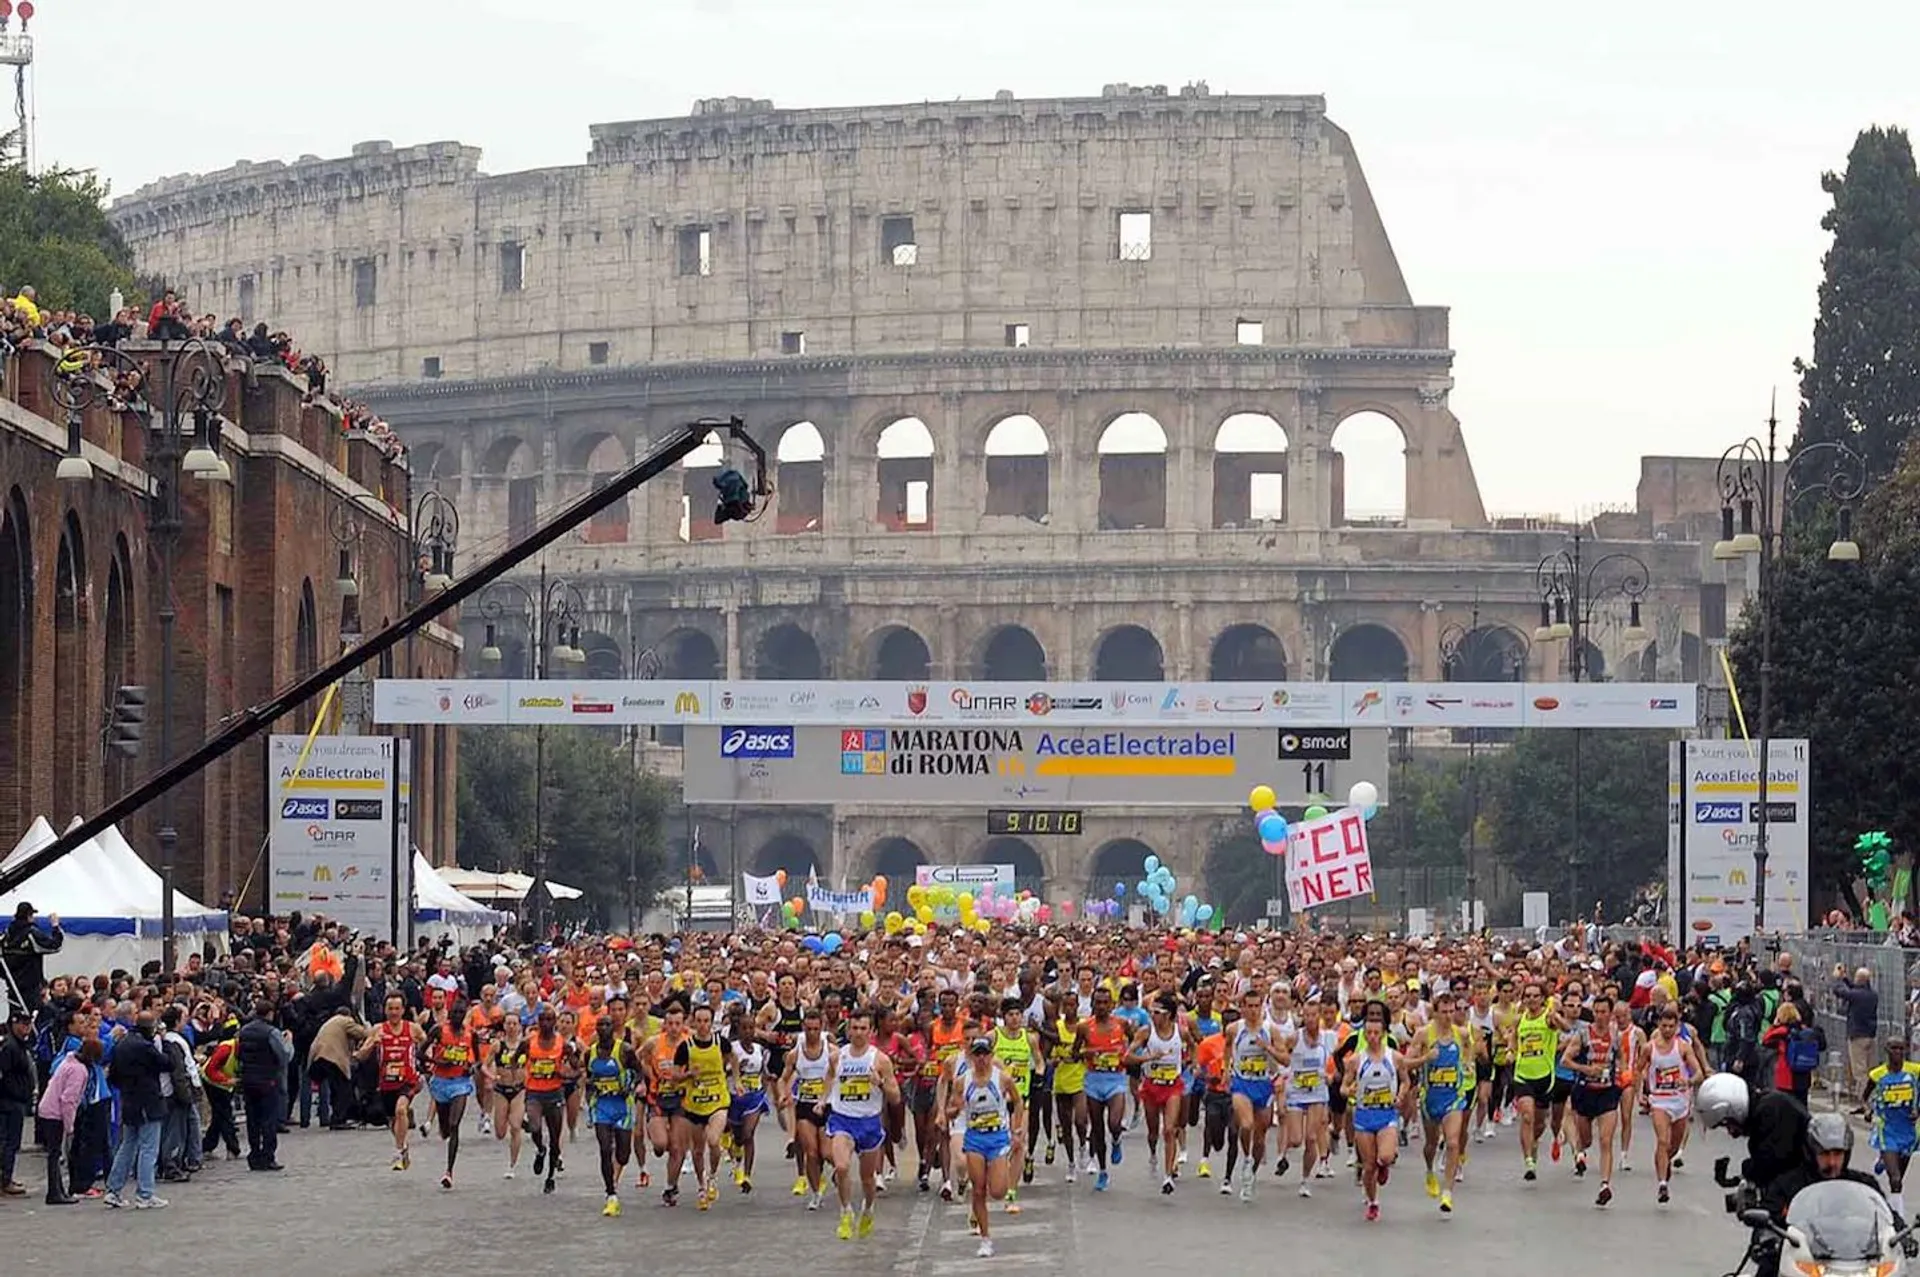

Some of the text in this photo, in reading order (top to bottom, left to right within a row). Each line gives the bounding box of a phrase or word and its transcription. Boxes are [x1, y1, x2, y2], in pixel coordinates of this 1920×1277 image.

[744, 734, 791, 751] asics
[890, 729, 1024, 751] MARATONA
[1036, 732, 1236, 756] AceaElectrabel
[1301, 734, 1348, 749] smart
[1701, 746, 1725, 758] Start
[890, 753, 913, 775] di
[919, 753, 991, 775] ROMA
[297, 801, 327, 815] asics
[350, 803, 381, 815] smart
